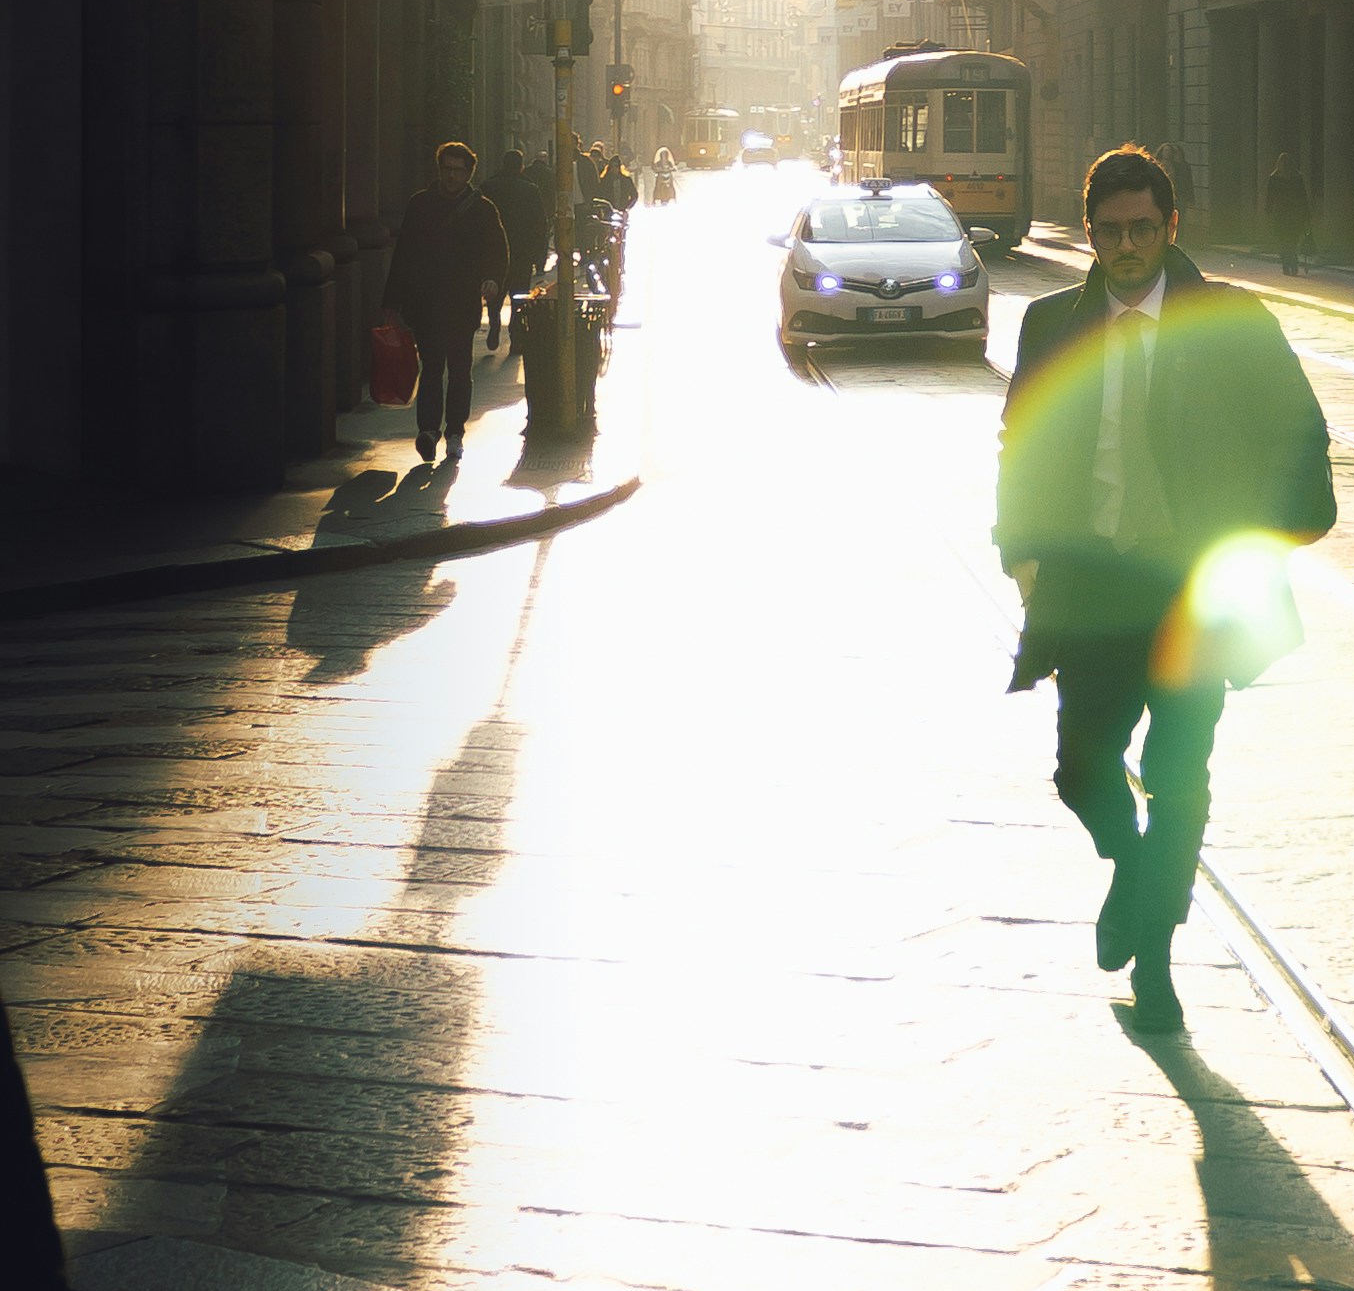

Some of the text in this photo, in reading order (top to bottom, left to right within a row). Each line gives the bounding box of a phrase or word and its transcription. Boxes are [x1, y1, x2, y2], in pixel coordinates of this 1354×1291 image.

[888, 2, 904, 13] EY
[857, 17, 871, 27] EY
[842, 24, 855, 33] EY
[864, 180, 889, 188] TAXI
